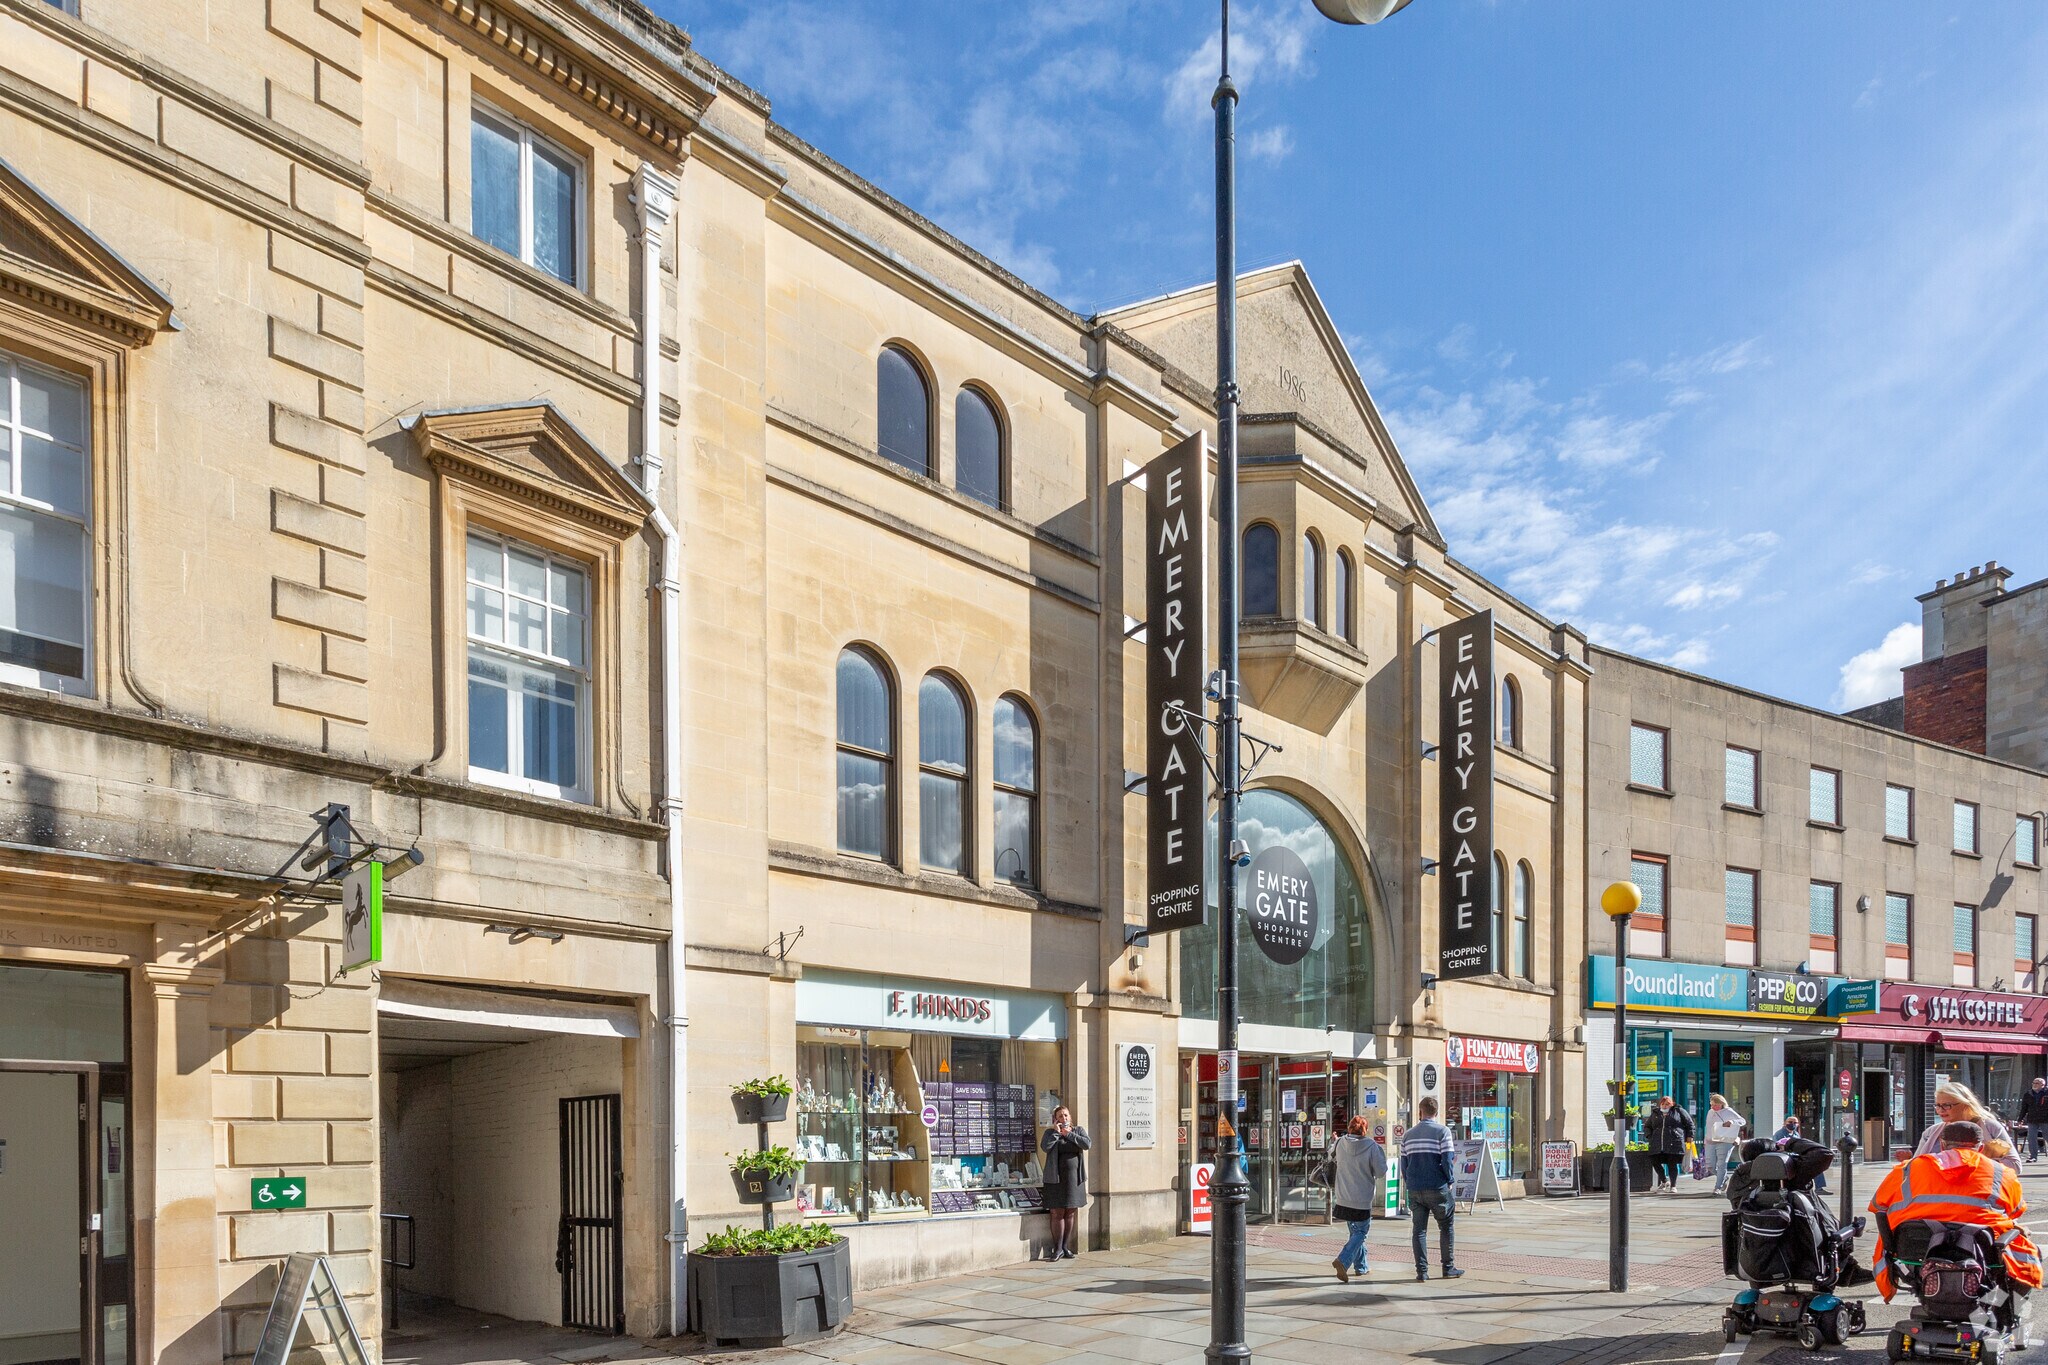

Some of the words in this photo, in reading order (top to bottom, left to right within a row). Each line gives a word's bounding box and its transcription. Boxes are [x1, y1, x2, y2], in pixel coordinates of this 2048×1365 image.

[1279, 366, 1307, 403] 1986
[1158, 467, 1189, 678] EMERY
[1451, 633, 1479, 790] EMERY
[1161, 699, 1188, 865] GATE
[1453, 806, 1477, 930] GATE
[1150, 884, 1200, 905] SHOPPING
[1257, 869, 1308, 898] EMERY
[1157, 901, 1193, 918] CENTRE
[1256, 892, 1308, 925] GATE
[41, 931, 118, 948] LIMITED
[1257, 921, 1309, 938] SHOPPING
[1264, 934, 1302, 947] CENTRE
[1442, 944, 1488, 960] SHOPPING
[1448, 957, 1481, 969] CENTRE
[1624, 968, 1715, 998] Poundland
[893, 991, 908, 1014] F.
[917, 993, 991, 1021] HINDS
[1962, 999, 2024, 1024] COFFEE
[1466, 1038, 1494, 1058] FONE
[1495, 1041, 1522, 1060] ZONE
[1129, 1060, 1147, 1068] GATE
[1194, 1206, 1212, 1214] ENTRANC
